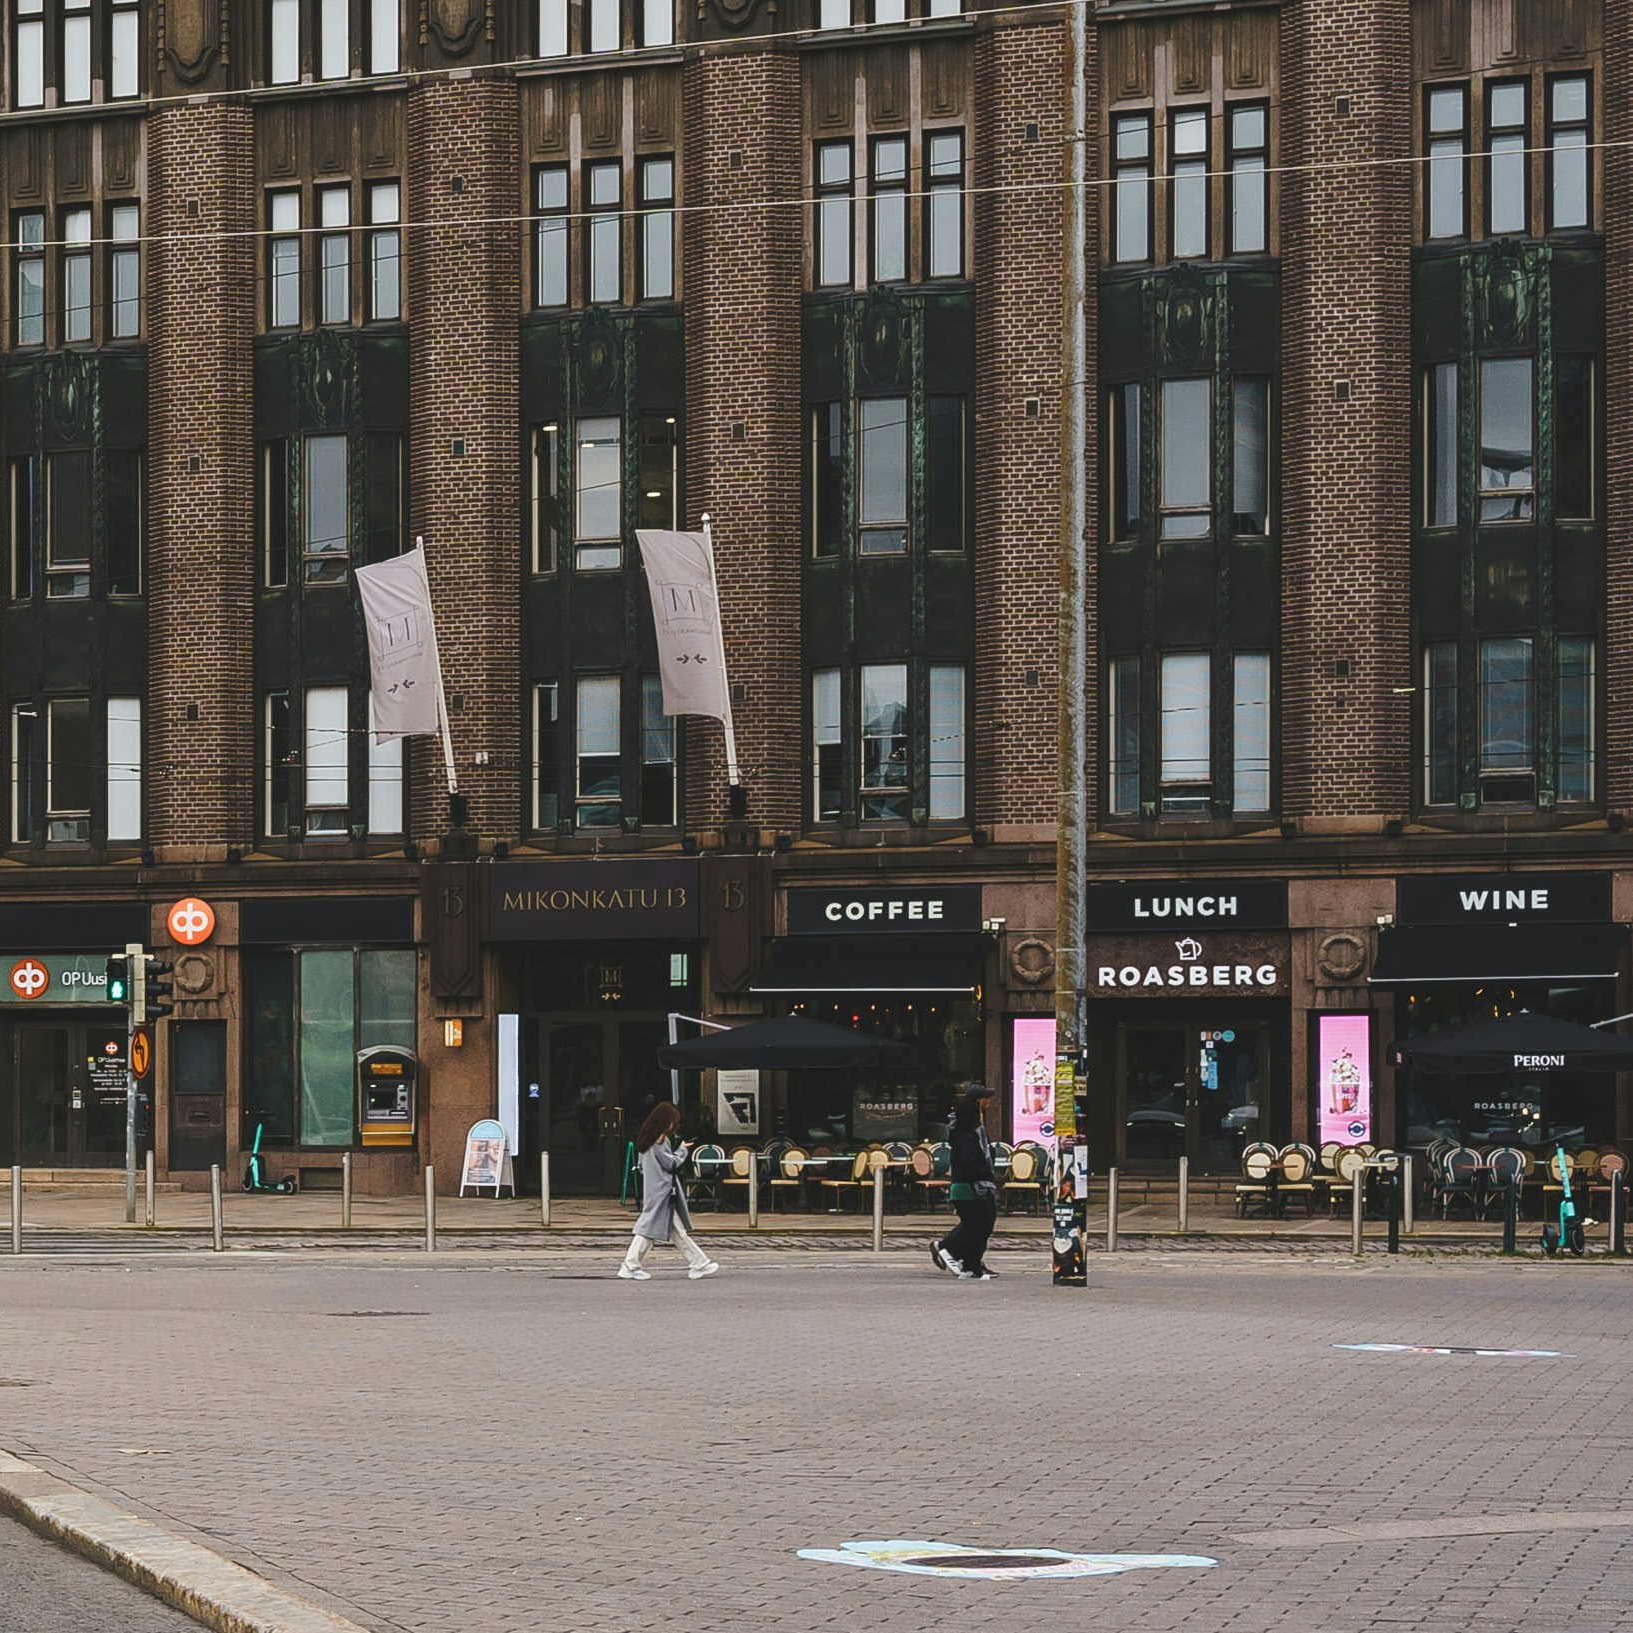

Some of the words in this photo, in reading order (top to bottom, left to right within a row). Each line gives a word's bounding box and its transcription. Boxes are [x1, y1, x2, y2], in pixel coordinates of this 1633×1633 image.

[442, 886, 465, 917] 13
[503, 887, 659, 911] MIKONKATU
[667, 886, 686, 909] 13
[721, 879, 745, 912] 13
[1459, 889, 1549, 911] WINE
[825, 900, 944, 921] COFFEE
[1134, 896, 1237, 917] LUNCH
[61, 971, 81, 986] OP
[1098, 964, 1277, 987] ROASBERG
[1513, 1054, 1565, 1067] PERONI
[859, 1102, 914, 1112] ROASBERG
[1474, 1102, 1534, 1110] ROASBERG
